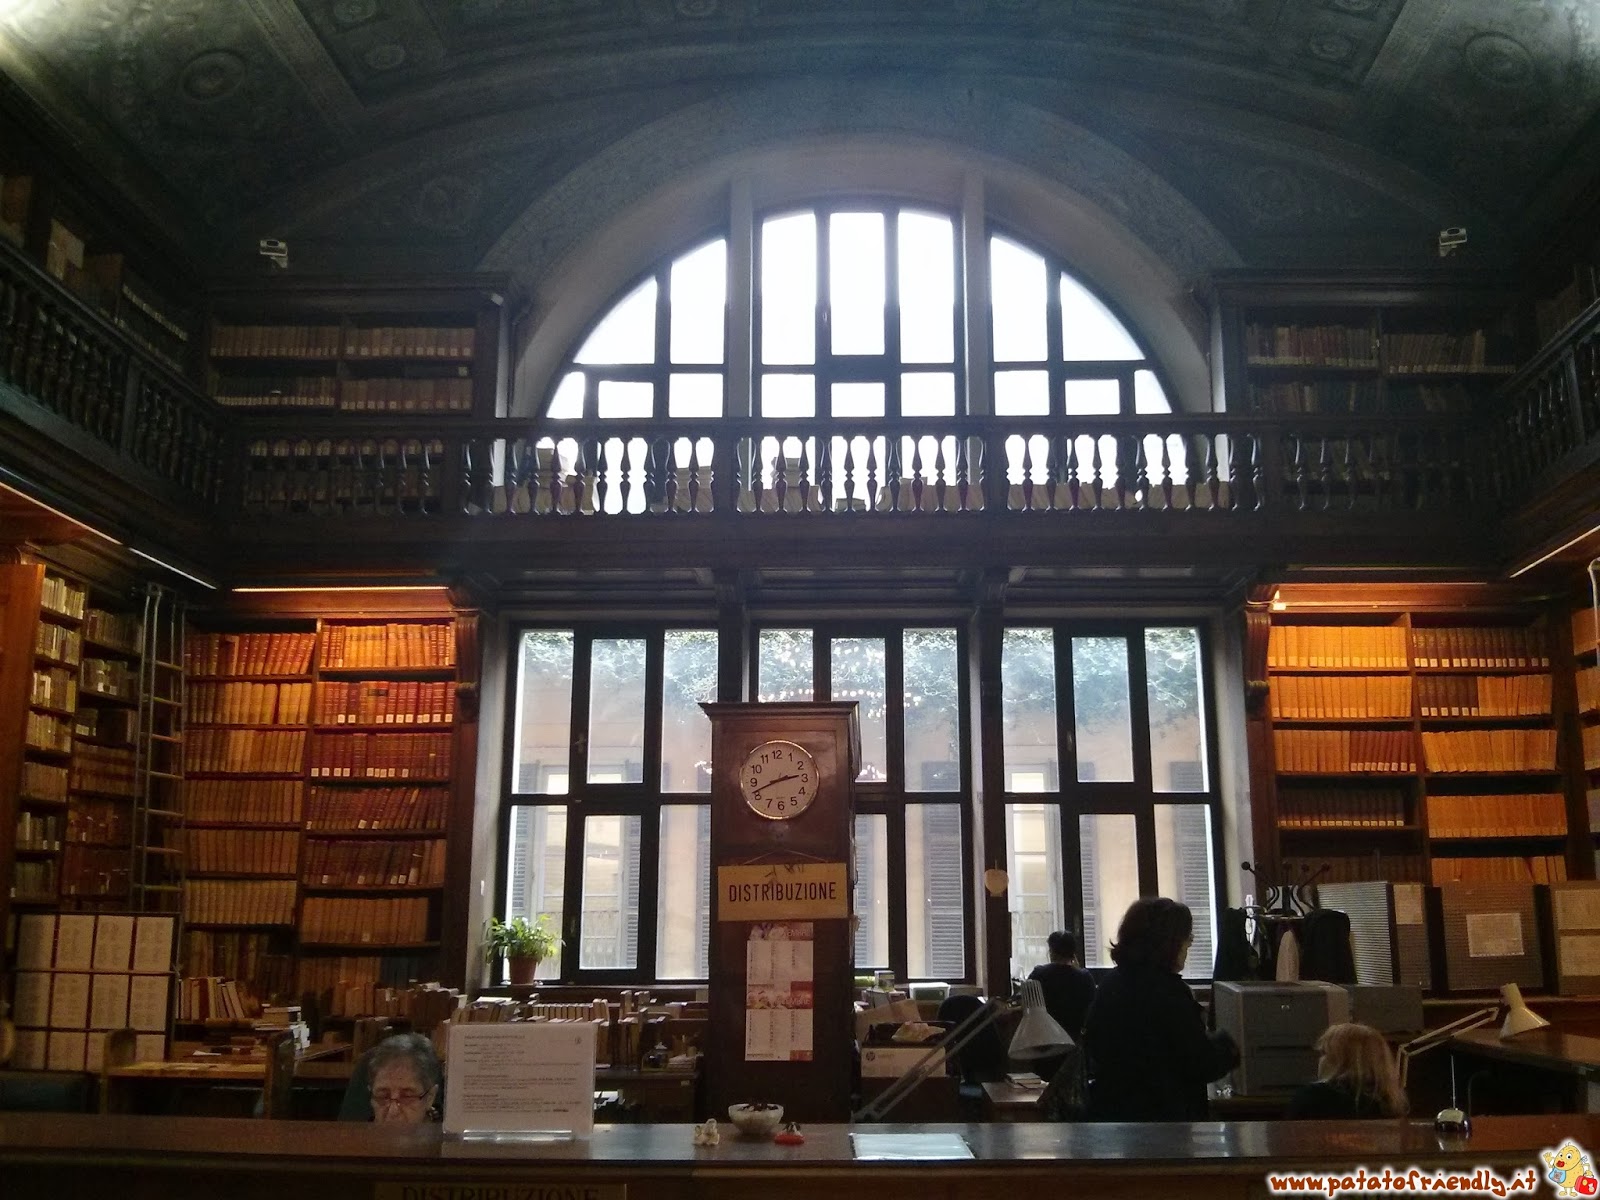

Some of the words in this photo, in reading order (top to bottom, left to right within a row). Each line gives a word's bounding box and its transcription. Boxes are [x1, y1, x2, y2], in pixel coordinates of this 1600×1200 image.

[760, 754, 769, 764] 11
[771, 749, 783, 760] 12
[751, 764, 762, 774] 10
[797, 760, 805, 771] 2
[750, 777, 758, 787] 9
[801, 773, 809, 783] 3
[754, 790, 762, 801] 8
[798, 786, 806, 795] 4
[765, 798, 773, 809] 7
[777, 801, 785, 811] 6
[790, 796, 798, 806] 5
[729, 881, 837, 903] DISTRIBUZIONE
